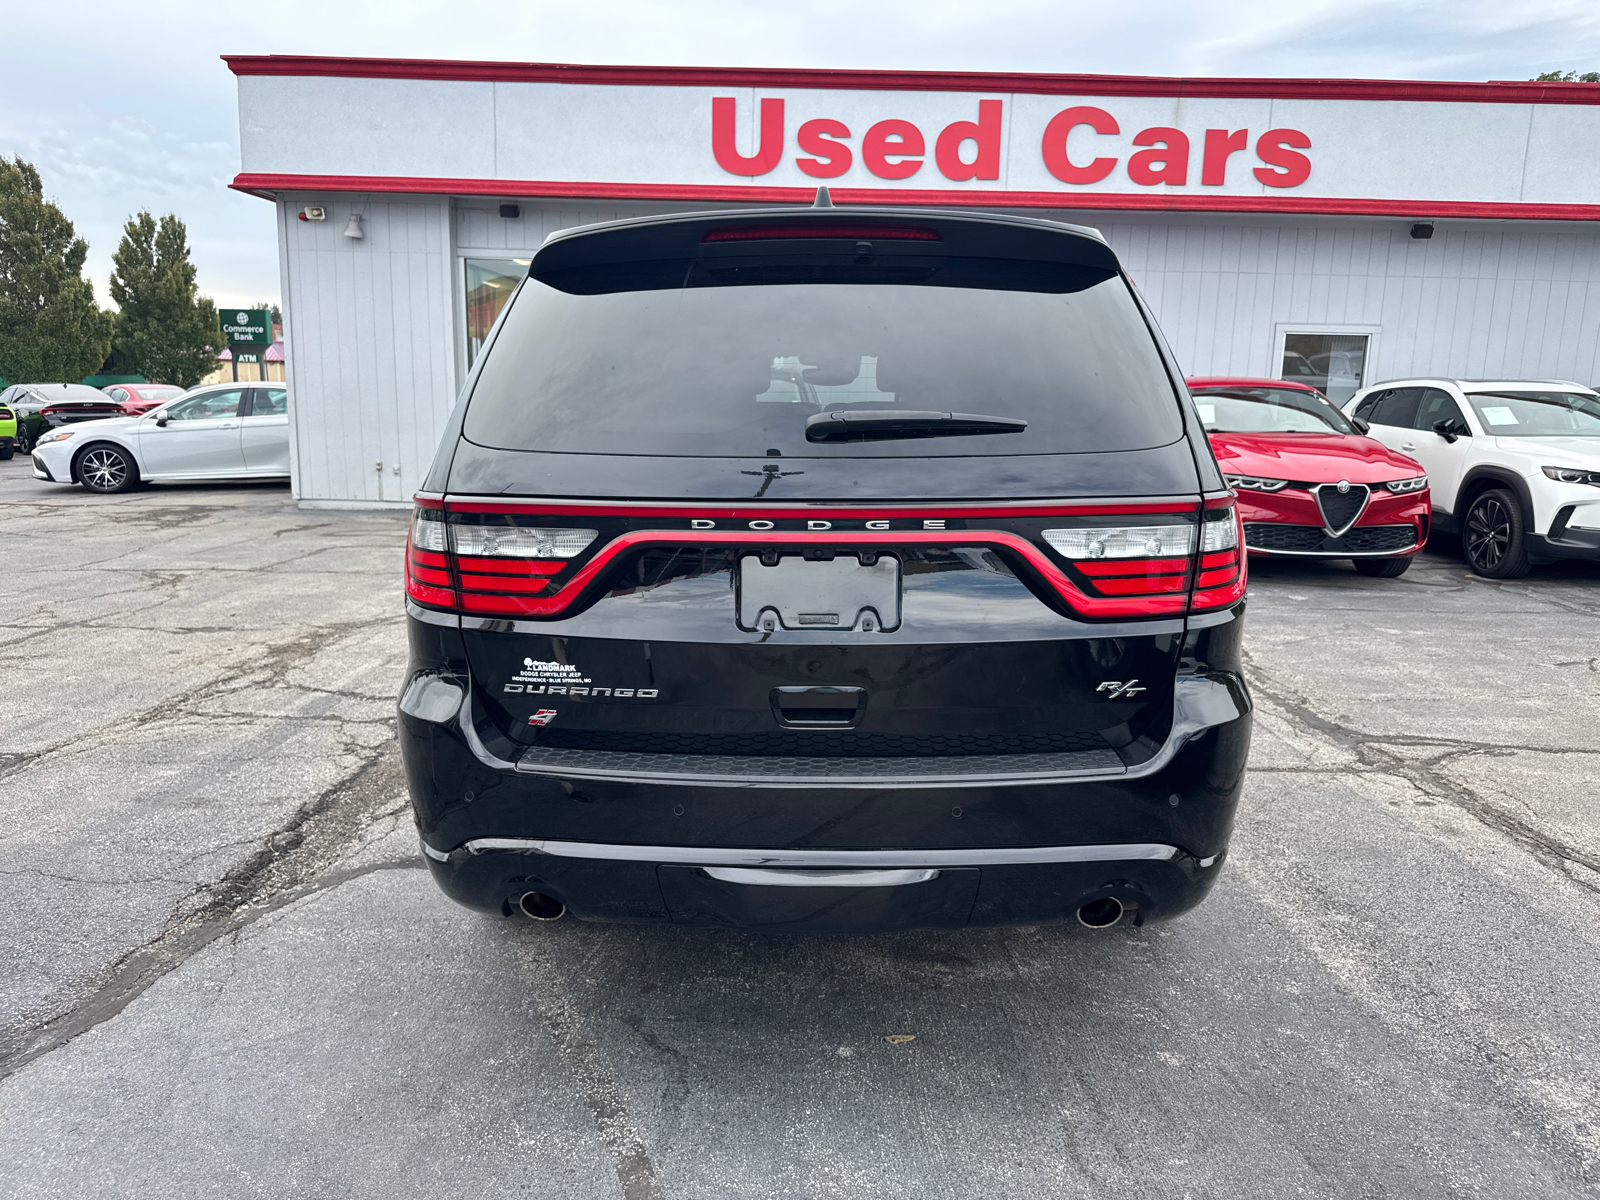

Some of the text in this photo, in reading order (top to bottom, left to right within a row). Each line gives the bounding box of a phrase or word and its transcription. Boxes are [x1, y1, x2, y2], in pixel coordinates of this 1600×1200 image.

[711, 96, 1312, 188] Used Cars
[223, 324, 264, 334] Commerce
[234, 333, 254, 341] Bank
[237, 354, 257, 362] ATM
[691, 519, 946, 530] DODGE
[532, 664, 576, 672] LANDMARK
[503, 683, 659, 698] DURANGO
[1095, 679, 1147, 699] R/T
